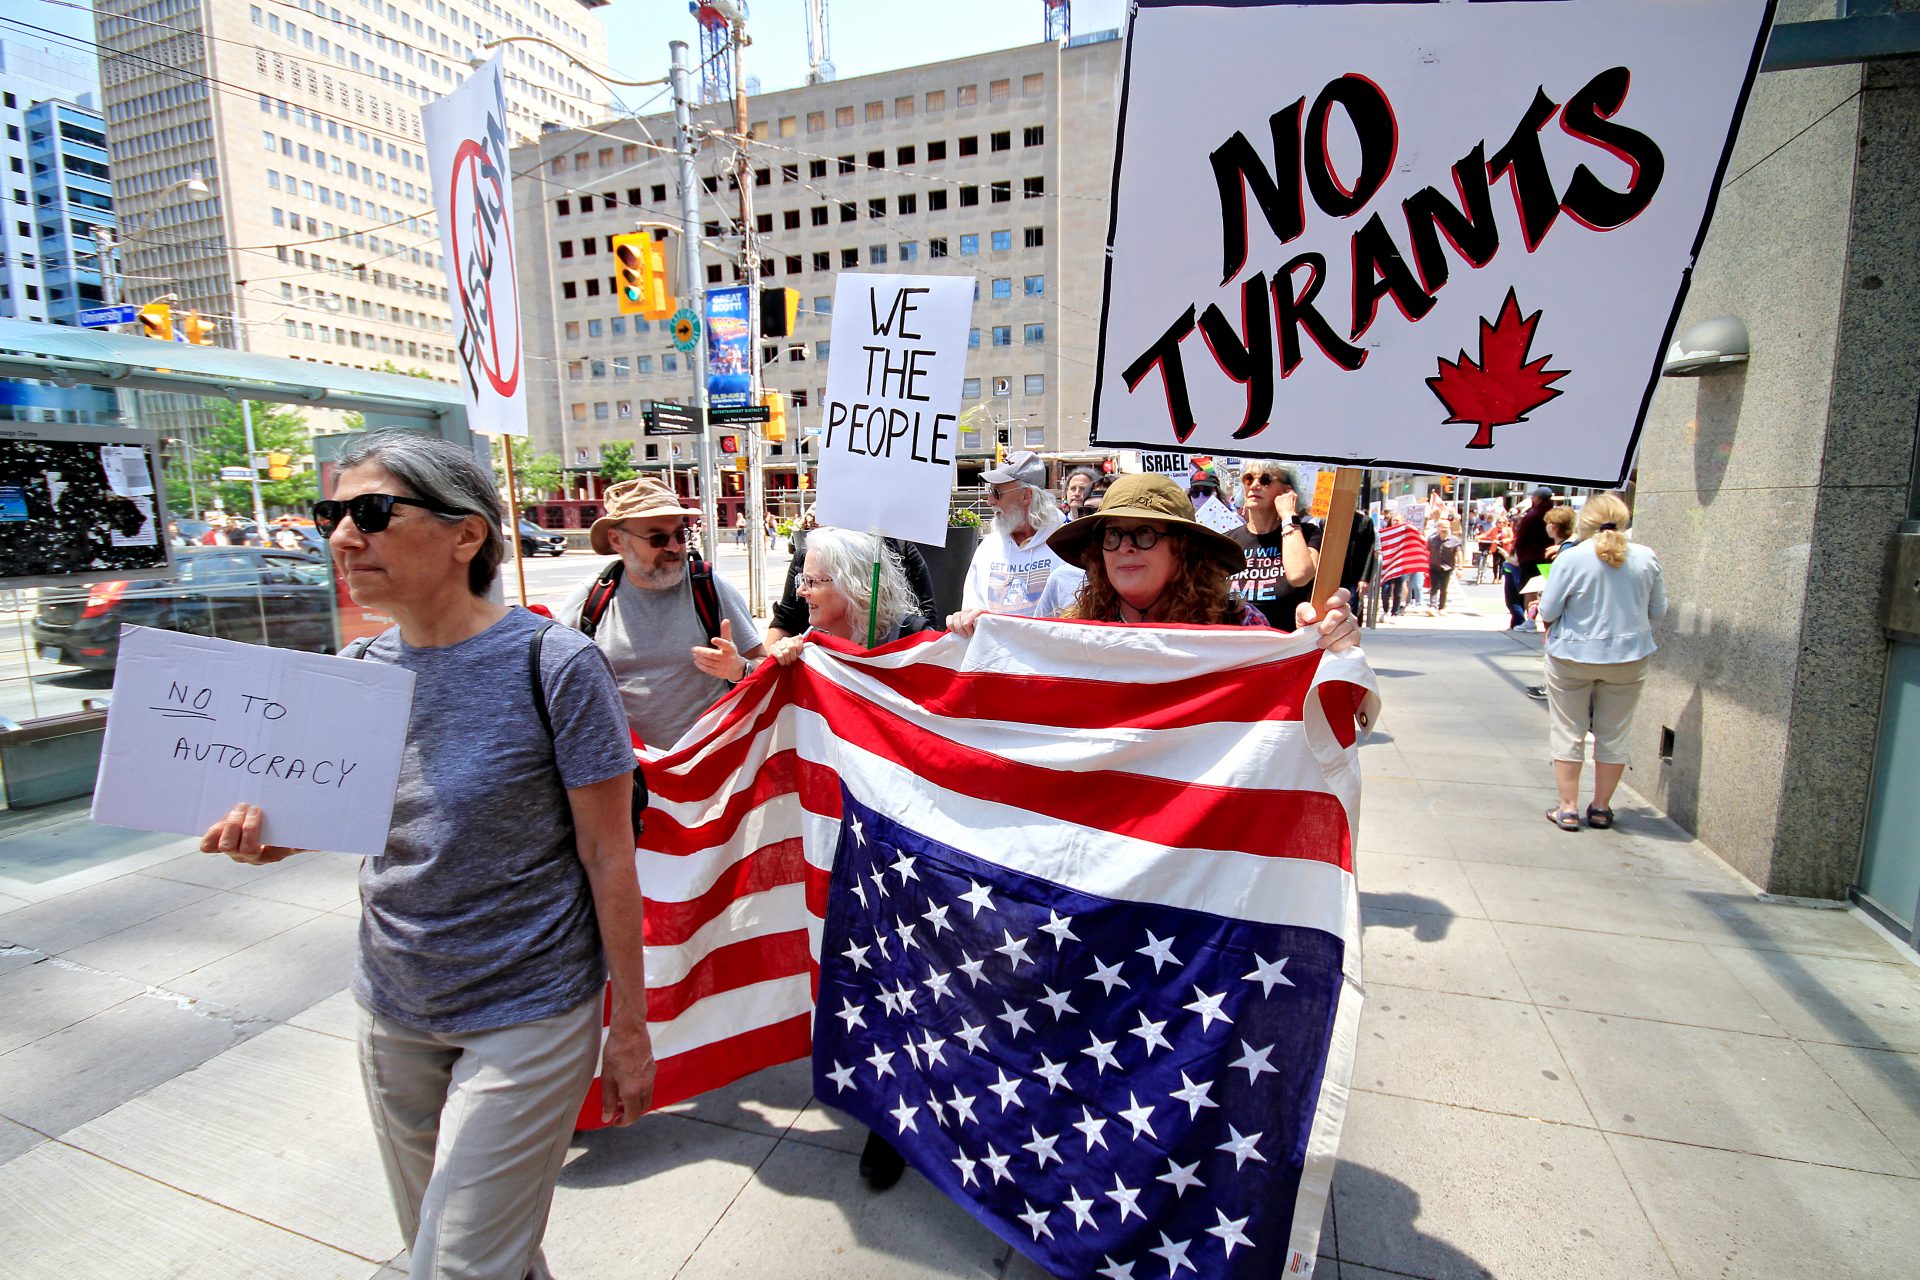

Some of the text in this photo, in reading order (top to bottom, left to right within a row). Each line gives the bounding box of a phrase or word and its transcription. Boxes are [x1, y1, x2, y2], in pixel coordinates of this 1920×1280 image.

[1209, 72, 1398, 287] NO
[458, 64, 506, 406] FASCISM
[1122, 67, 1664, 443] TYRANTS
[871, 287, 930, 340] WE
[863, 346, 937, 401] THE
[826, 402, 956, 465] PEOPLE
[1141, 454, 1188, 473] ISRAEL
[990, 561, 1006, 571] GET
[1018, 558, 1052, 573] LOSER
[1256, 546, 1281, 558] WIL
[1256, 557, 1272, 568] TO
[1273, 557, 1281, 566] G
[1229, 578, 1277, 601] ME
[168, 681, 287, 720] NO TO
[173, 737, 358, 788] AUTOCRACY
